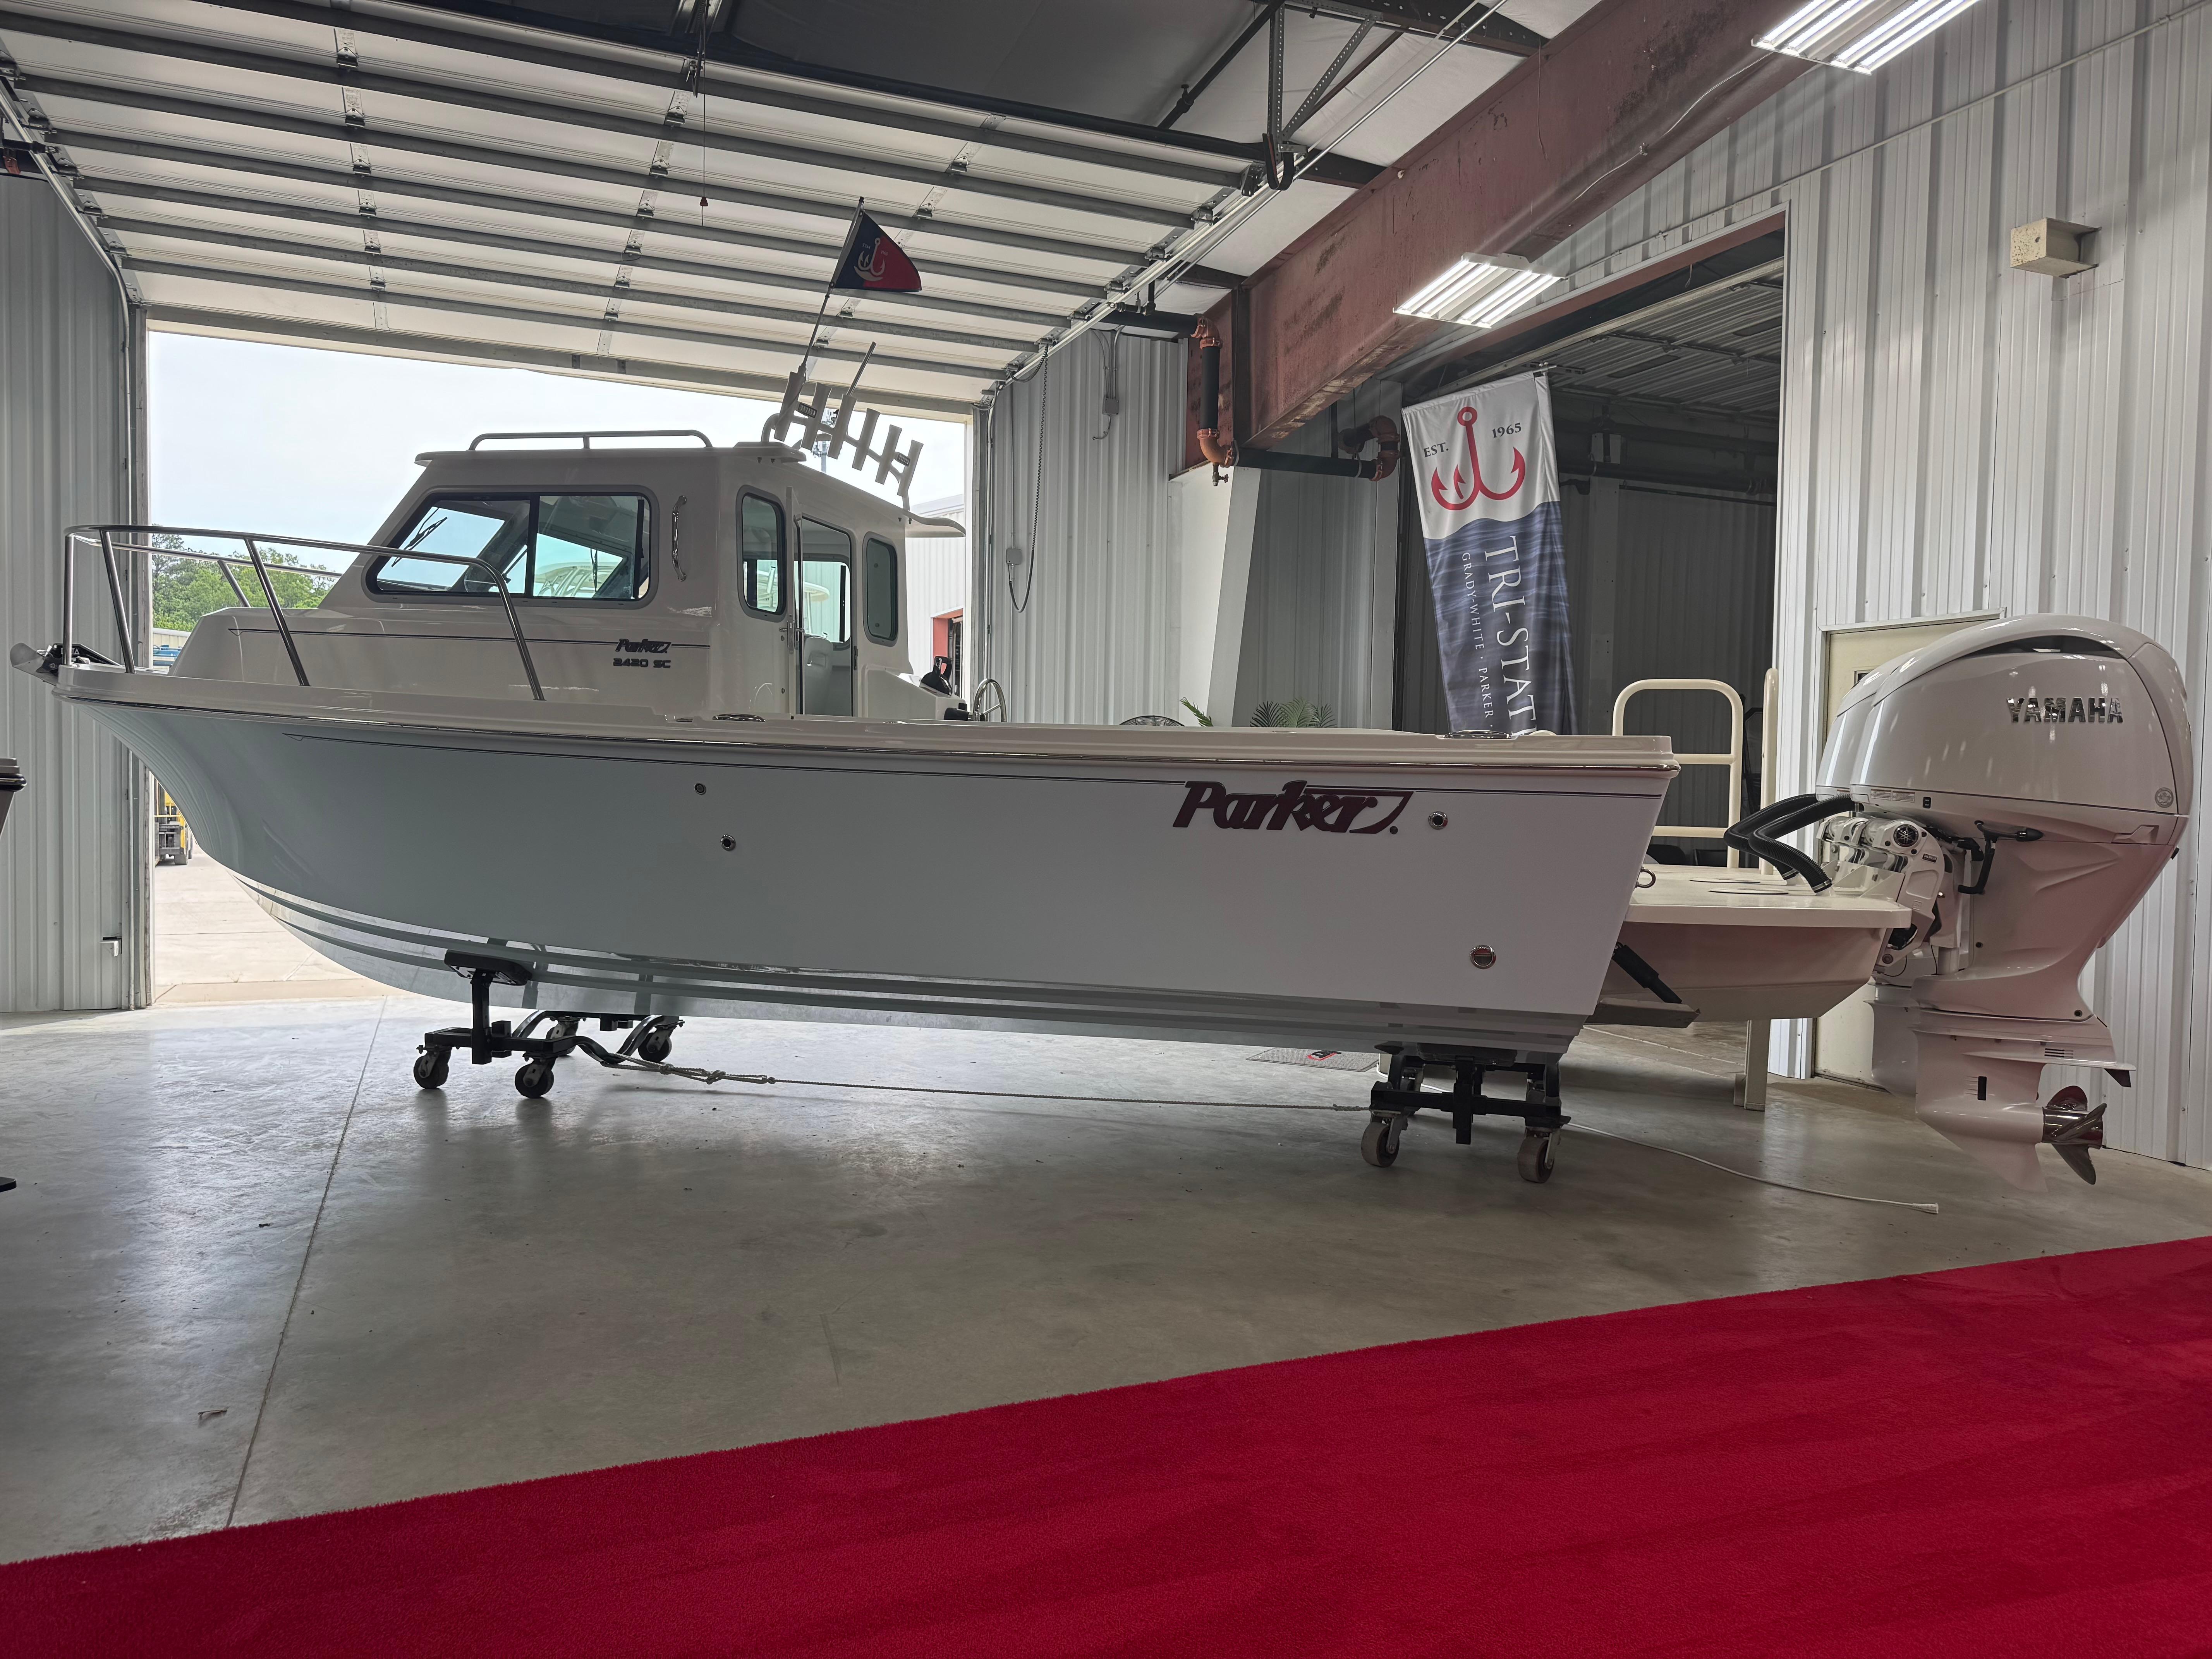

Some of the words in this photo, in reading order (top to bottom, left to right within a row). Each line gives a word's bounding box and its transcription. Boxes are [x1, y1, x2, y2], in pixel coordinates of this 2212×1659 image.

[1423, 442, 1449, 457] EST.
[1492, 422, 1522, 438] 1965
[615, 638, 671, 653] Parker
[1462, 552, 1484, 650] GRADY-WHITE
[1479, 667, 1494, 718] PARKER
[613, 658, 649, 667] 2420
[653, 660, 671, 668] SC
[2006, 697, 2123, 723] YAMAHA
[1173, 780, 1413, 834] Parker
